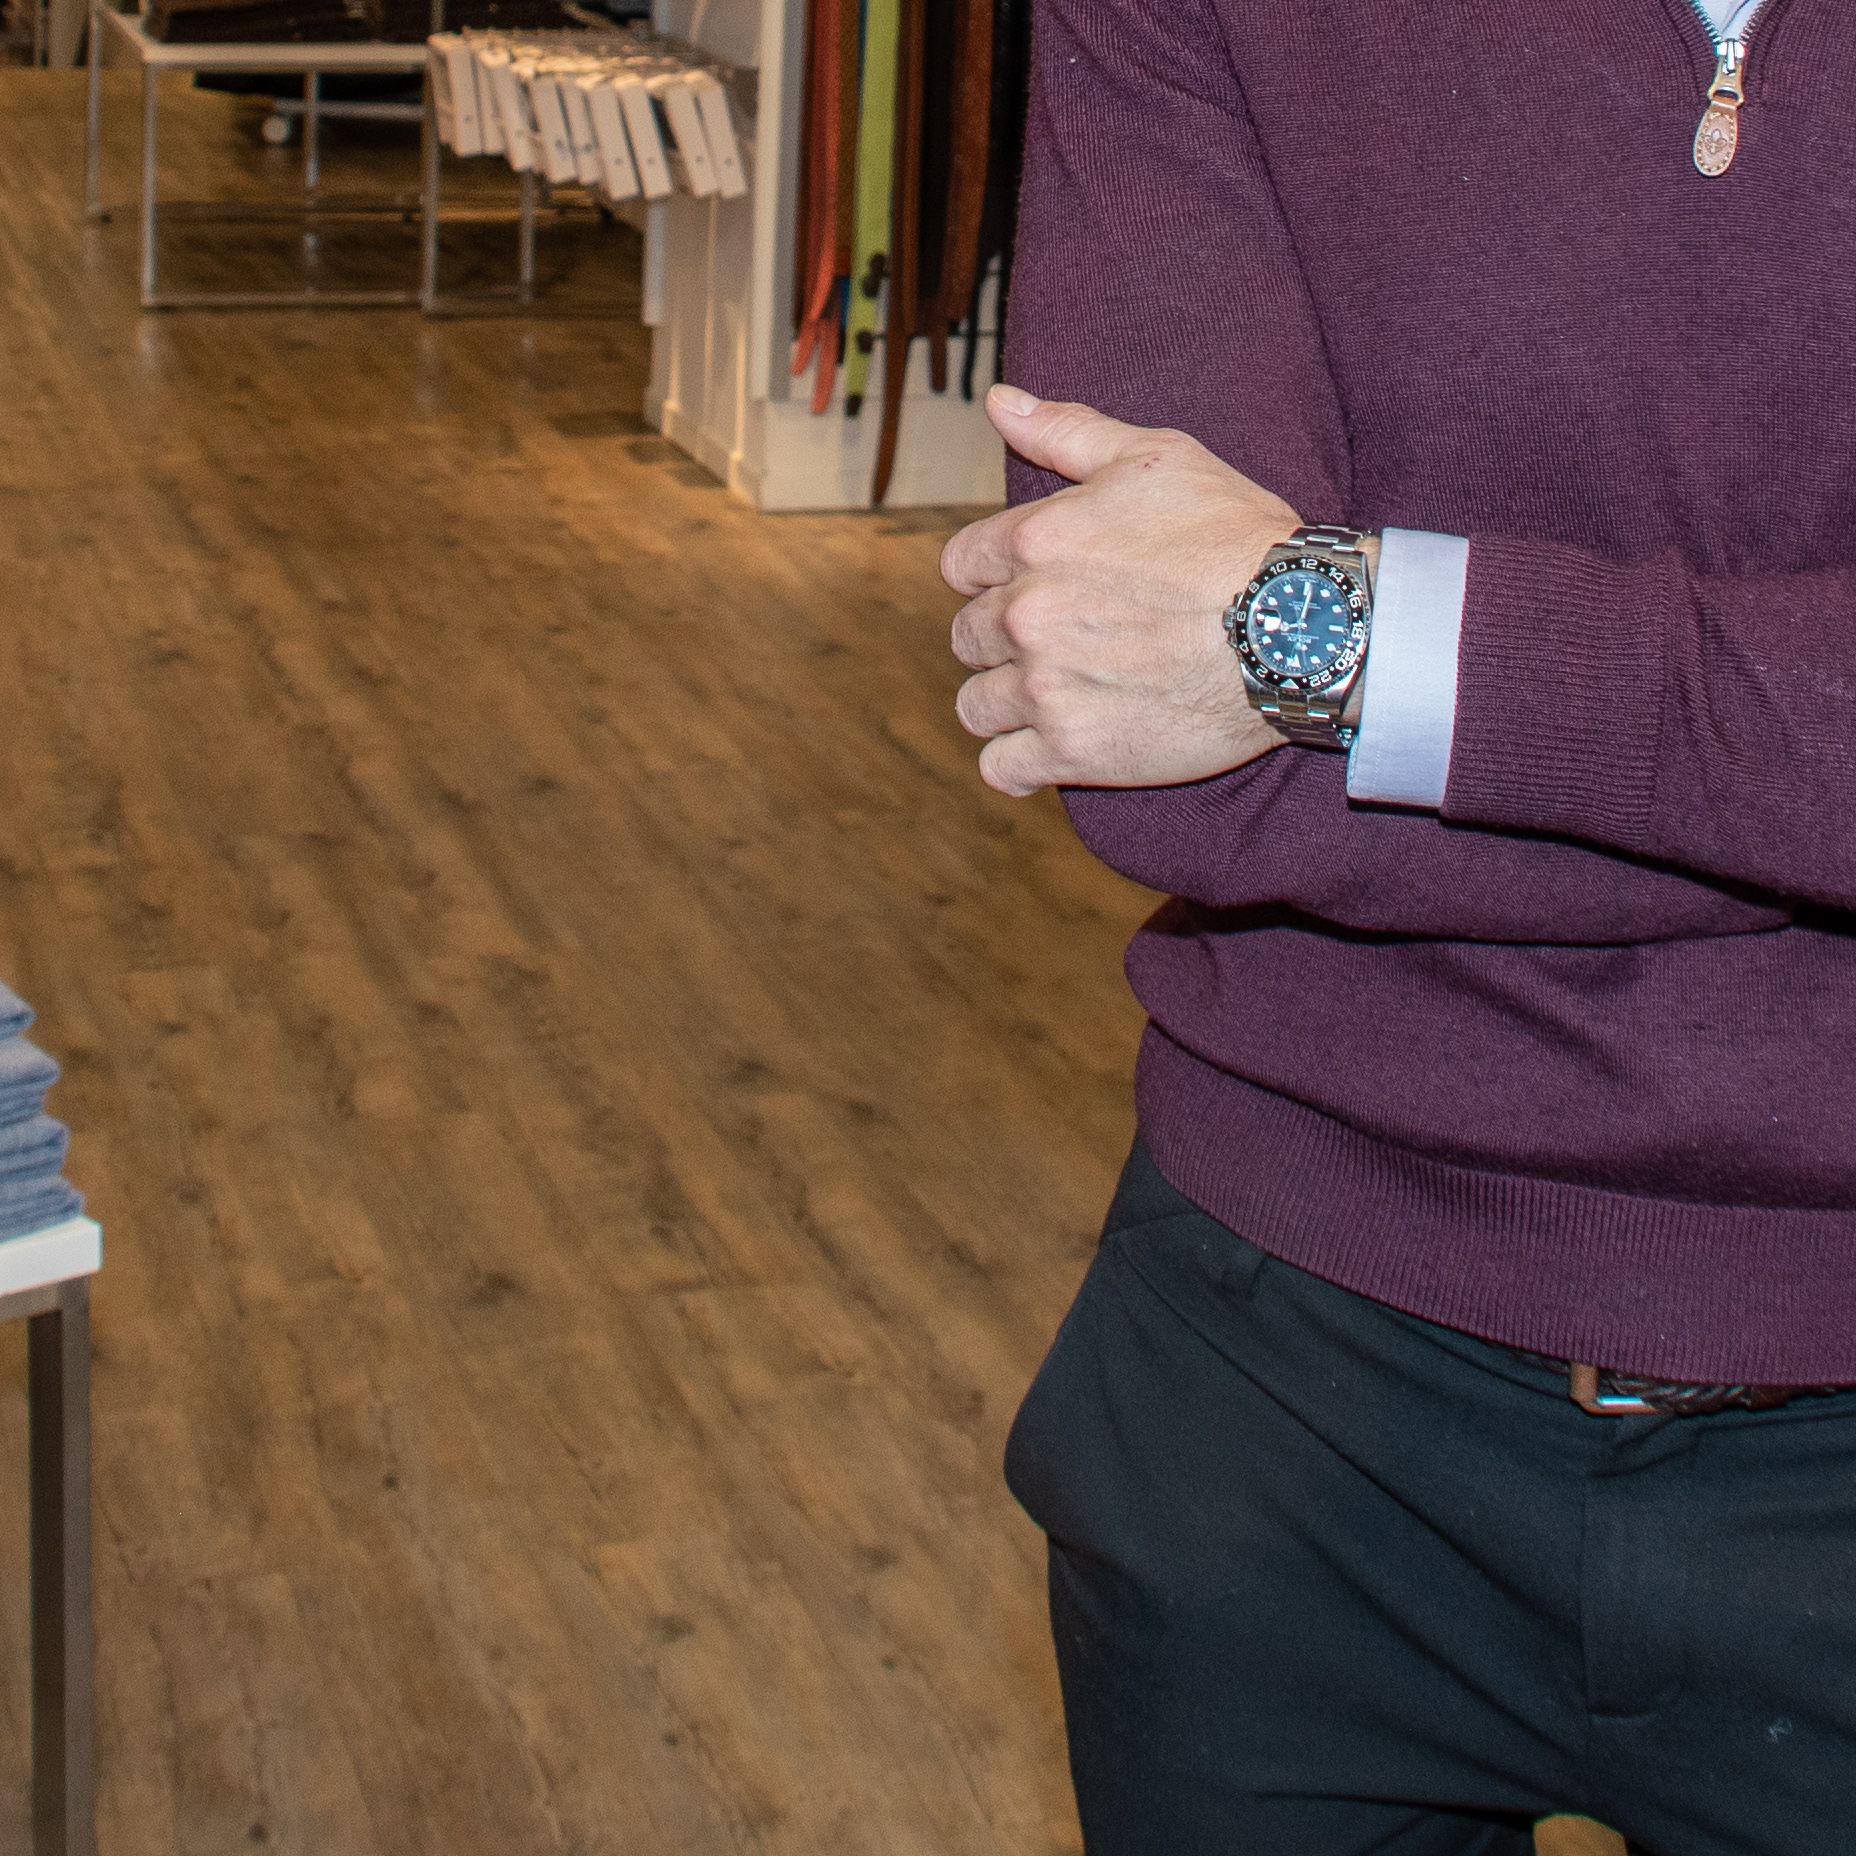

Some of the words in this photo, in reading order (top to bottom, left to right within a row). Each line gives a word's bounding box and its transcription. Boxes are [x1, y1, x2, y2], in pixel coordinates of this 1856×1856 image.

[1270, 561, 1287, 575] 10
[1300, 558, 1318, 569] 12
[1328, 567, 1344, 583] 14
[1348, 588, 1362, 607] 16
[1351, 620, 1363, 638] 18
[1240, 643, 1250, 653] 4
[1335, 648, 1356, 670] 20
[1256, 666, 1269, 678] 2
[1308, 671, 1332, 688] 22
